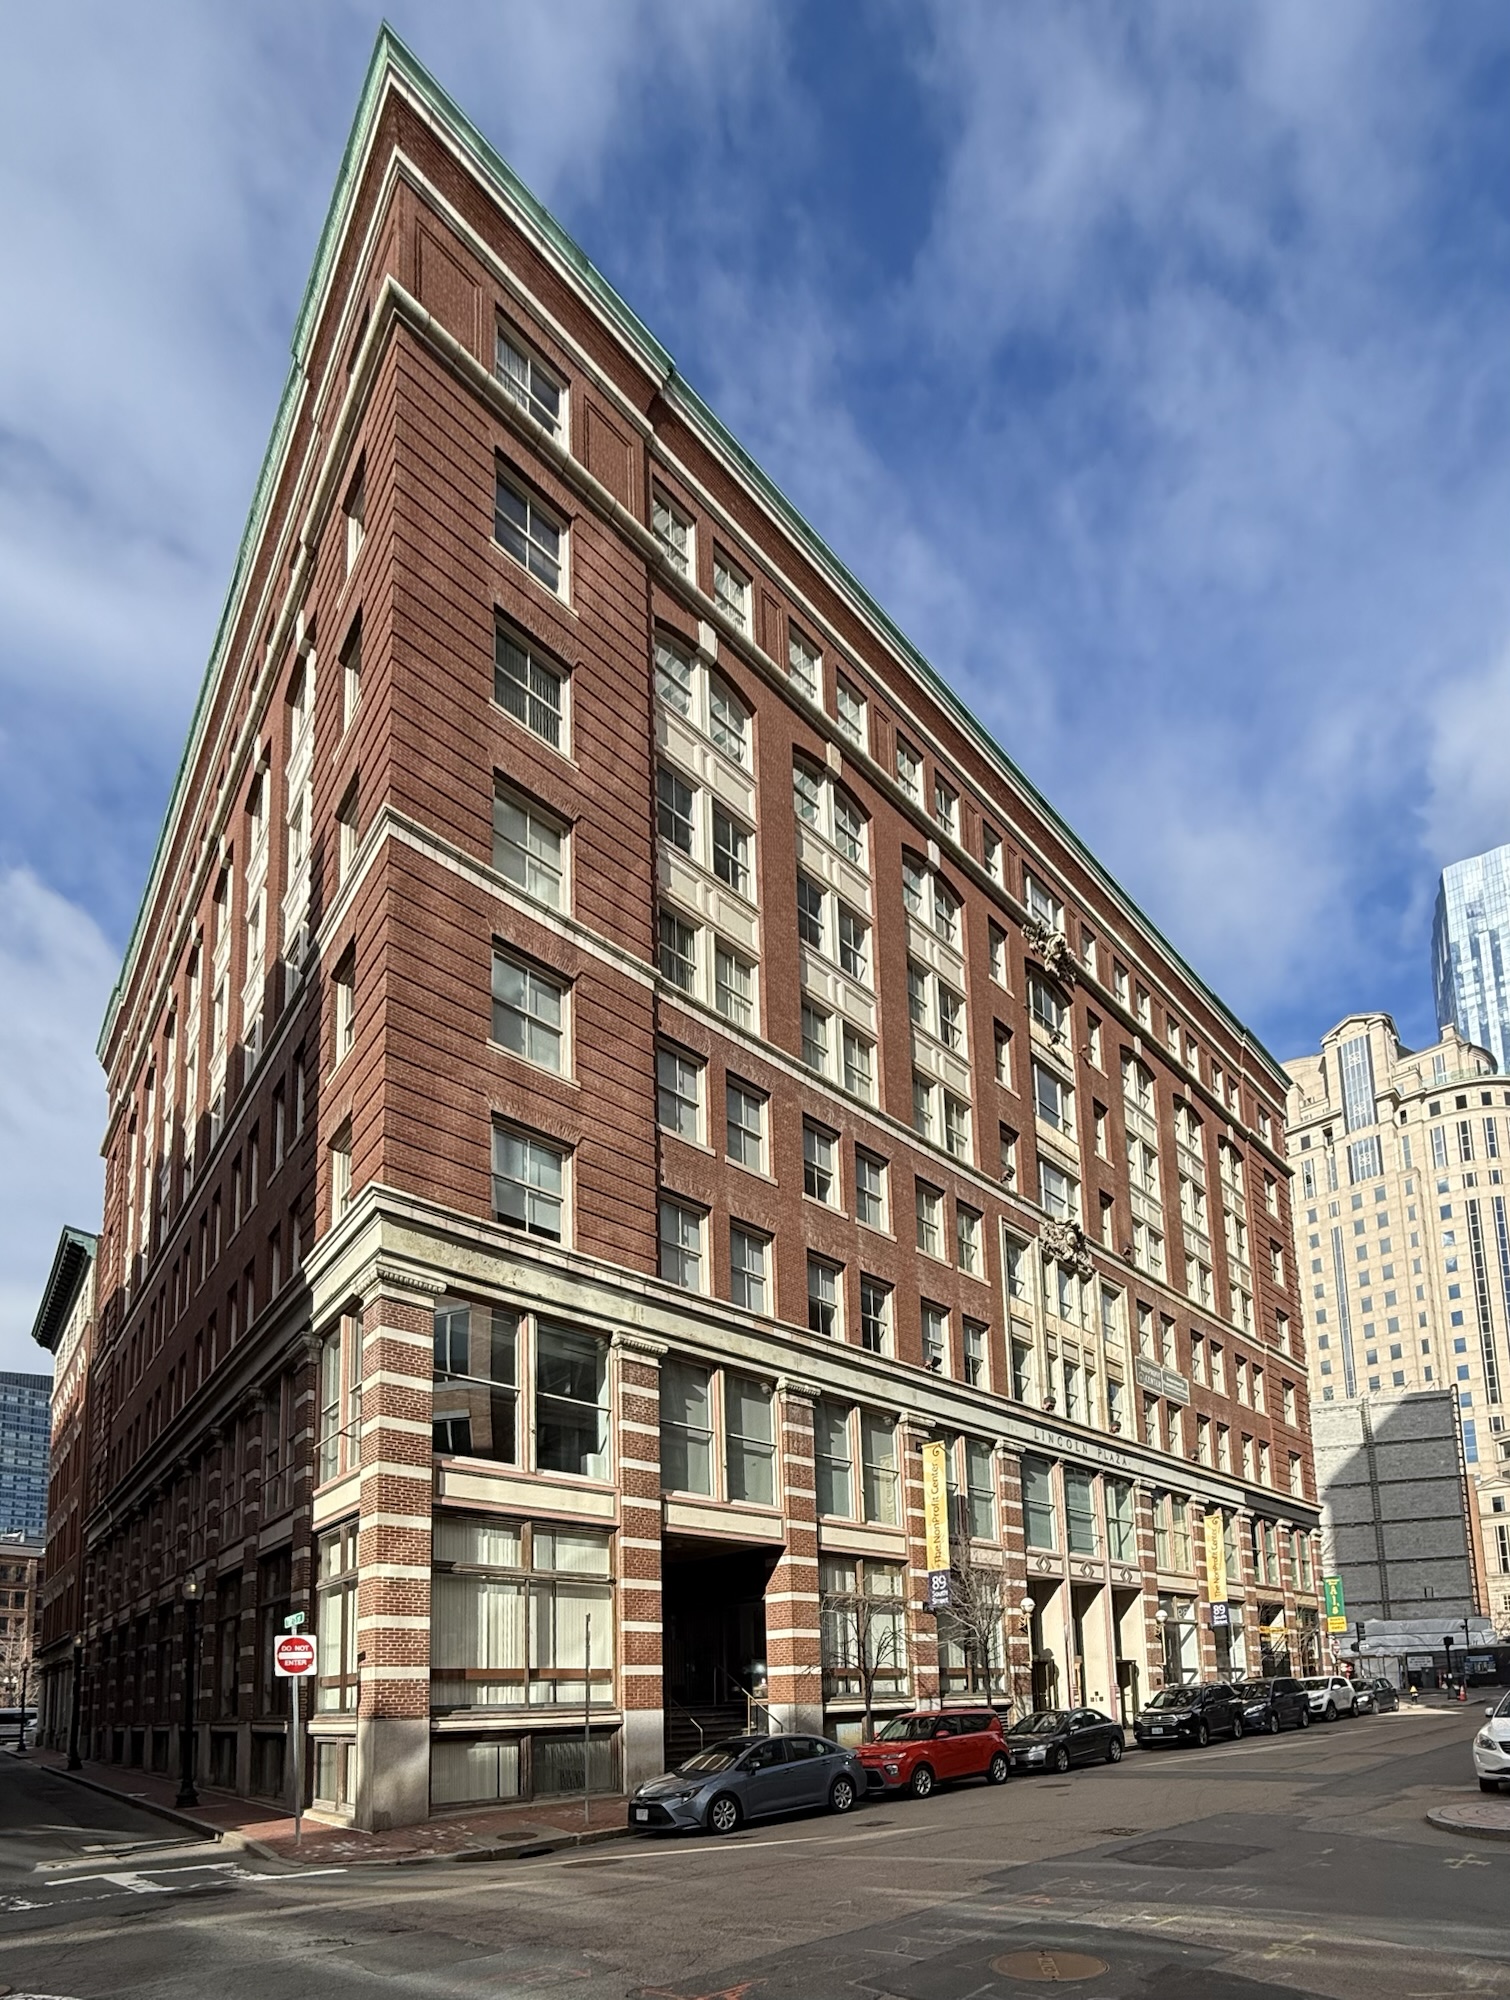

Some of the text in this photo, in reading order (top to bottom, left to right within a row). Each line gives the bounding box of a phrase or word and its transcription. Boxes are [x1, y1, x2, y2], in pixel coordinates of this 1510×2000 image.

[1033, 1428, 1088, 1454] LINCOLN
[1097, 1448, 1127, 1466] PLAZA
[931, 1463, 942, 1563] The NonProfit Center
[931, 1575, 947, 1590] 89
[1213, 1604, 1226, 1615] 89
